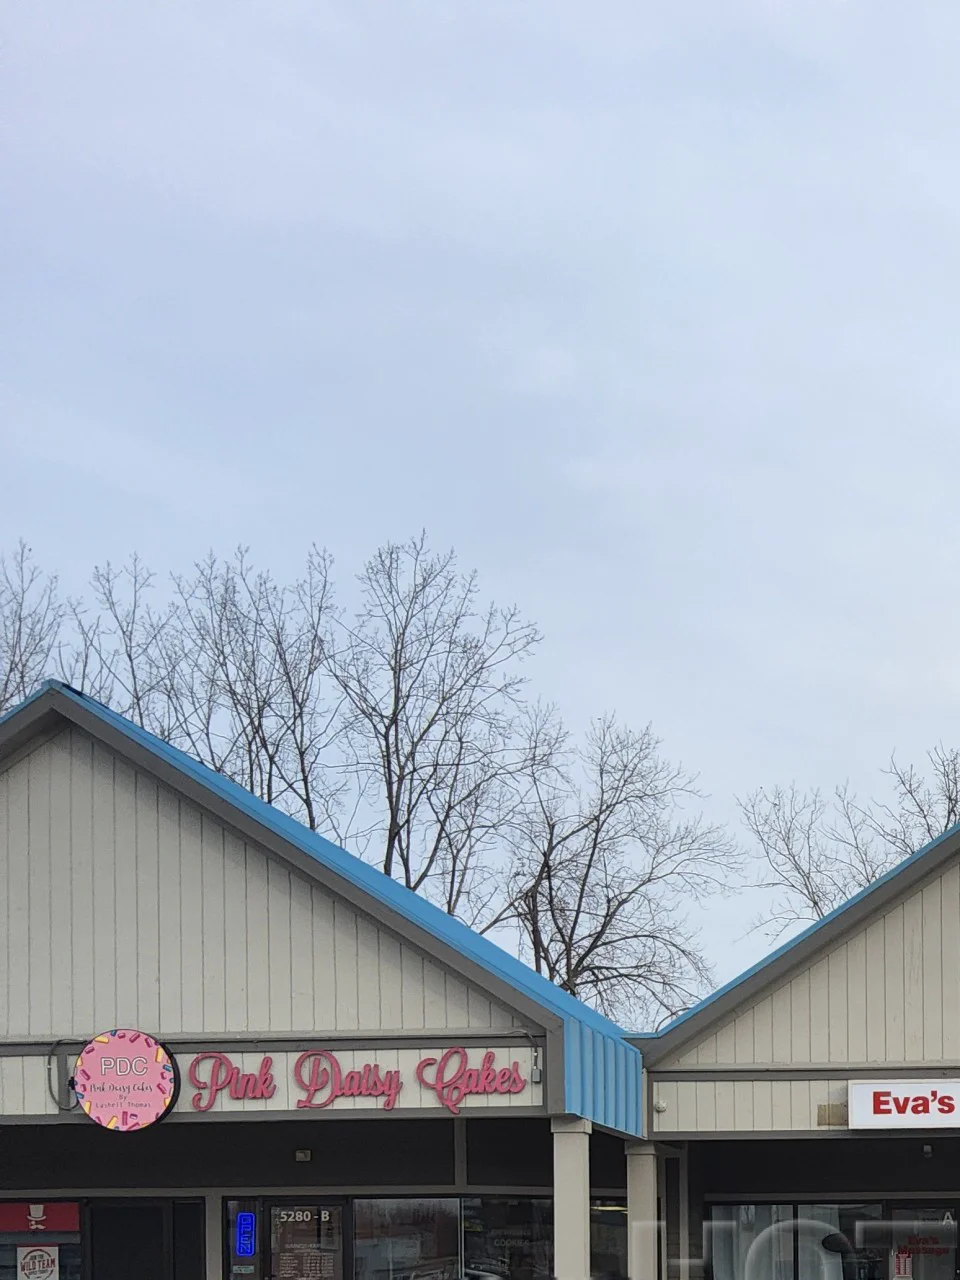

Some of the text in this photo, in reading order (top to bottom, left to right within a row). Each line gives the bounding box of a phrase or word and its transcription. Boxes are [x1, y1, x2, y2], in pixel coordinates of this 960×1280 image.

[100, 1056, 148, 1076] PDC
[90, 1081, 153, 1094] Pink Daisy Cakes
[188, 1046, 527, 1115] Pink Daisy Cakes
[872, 1089, 956, 1115] Eva's
[280, 1210, 312, 1222] 5280
[321, 1210, 330, 1222] B
[942, 1211, 955, 1225] A
[20, 1257, 56, 1273] WILD TEAM
